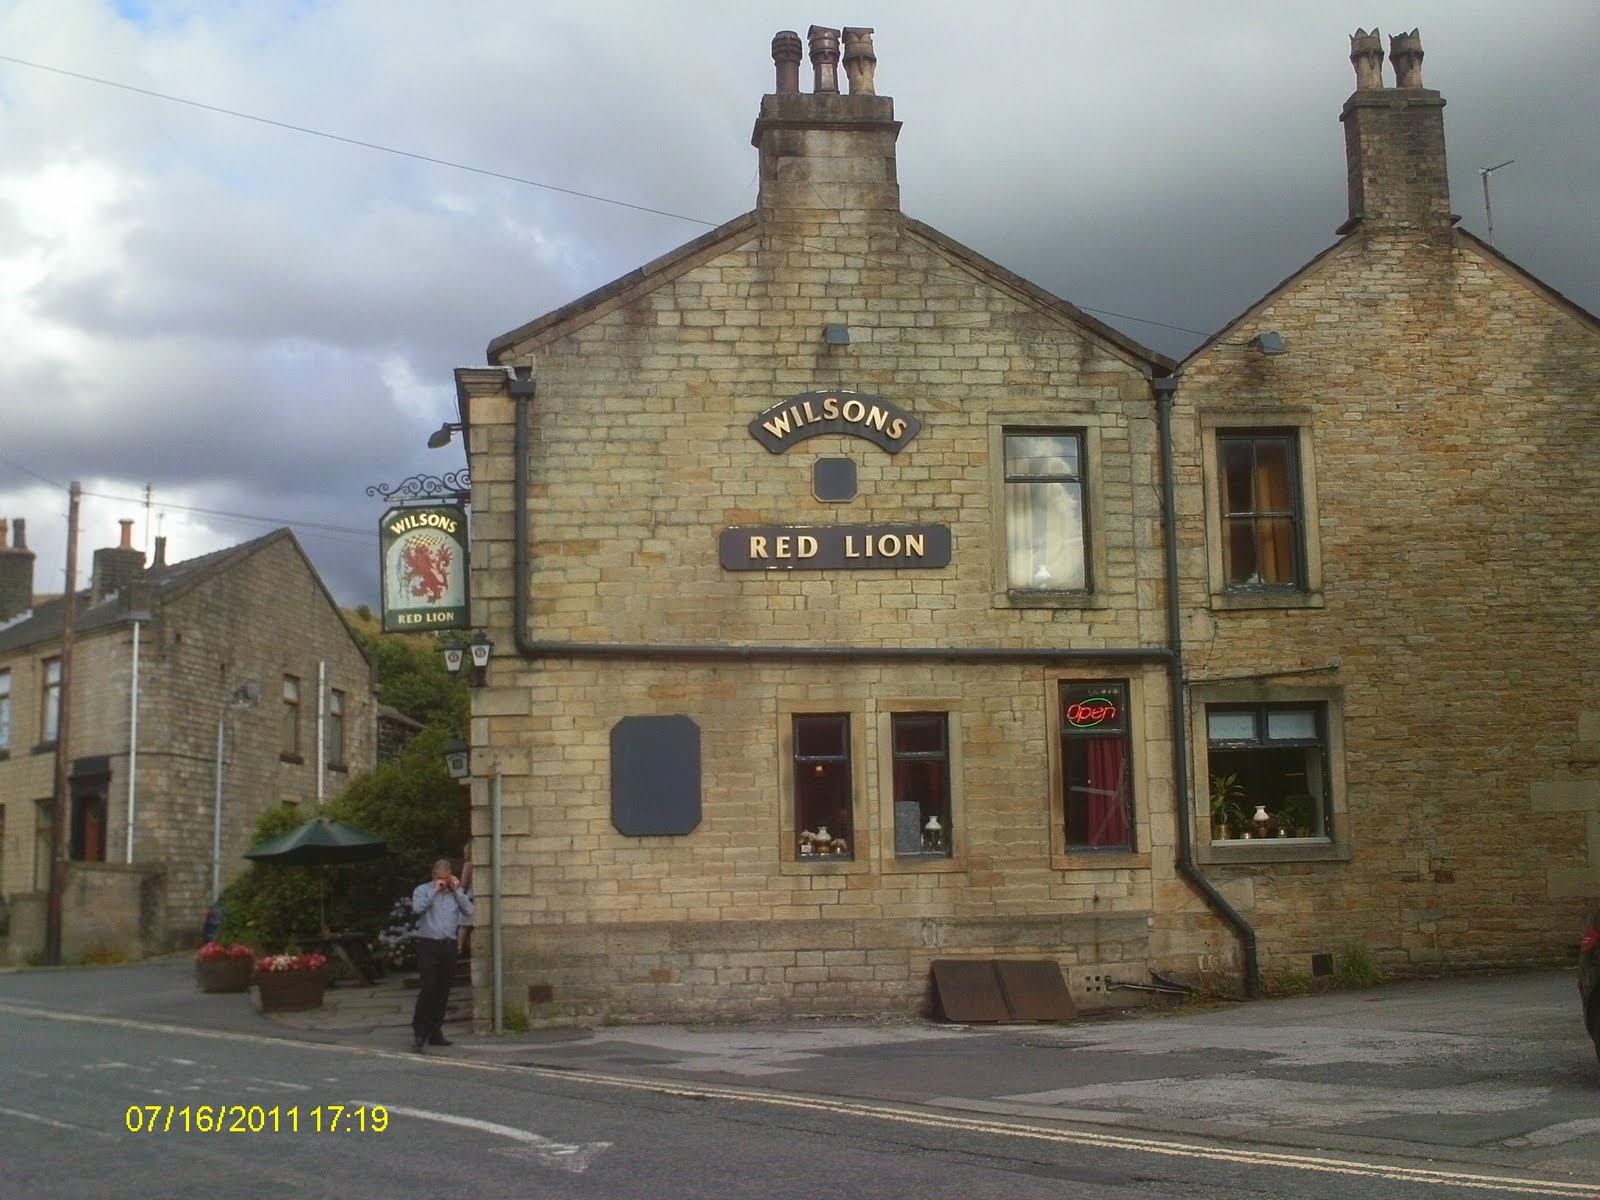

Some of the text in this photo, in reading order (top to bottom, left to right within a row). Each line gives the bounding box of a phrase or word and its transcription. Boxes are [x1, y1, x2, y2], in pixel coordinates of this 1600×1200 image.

[763, 398, 907, 439] WILSONS
[390, 513, 458, 535] WILSONS
[750, 534, 924, 559] RED LION
[398, 611, 454, 624] RED LION
[1067, 704, 1116, 723] Open
